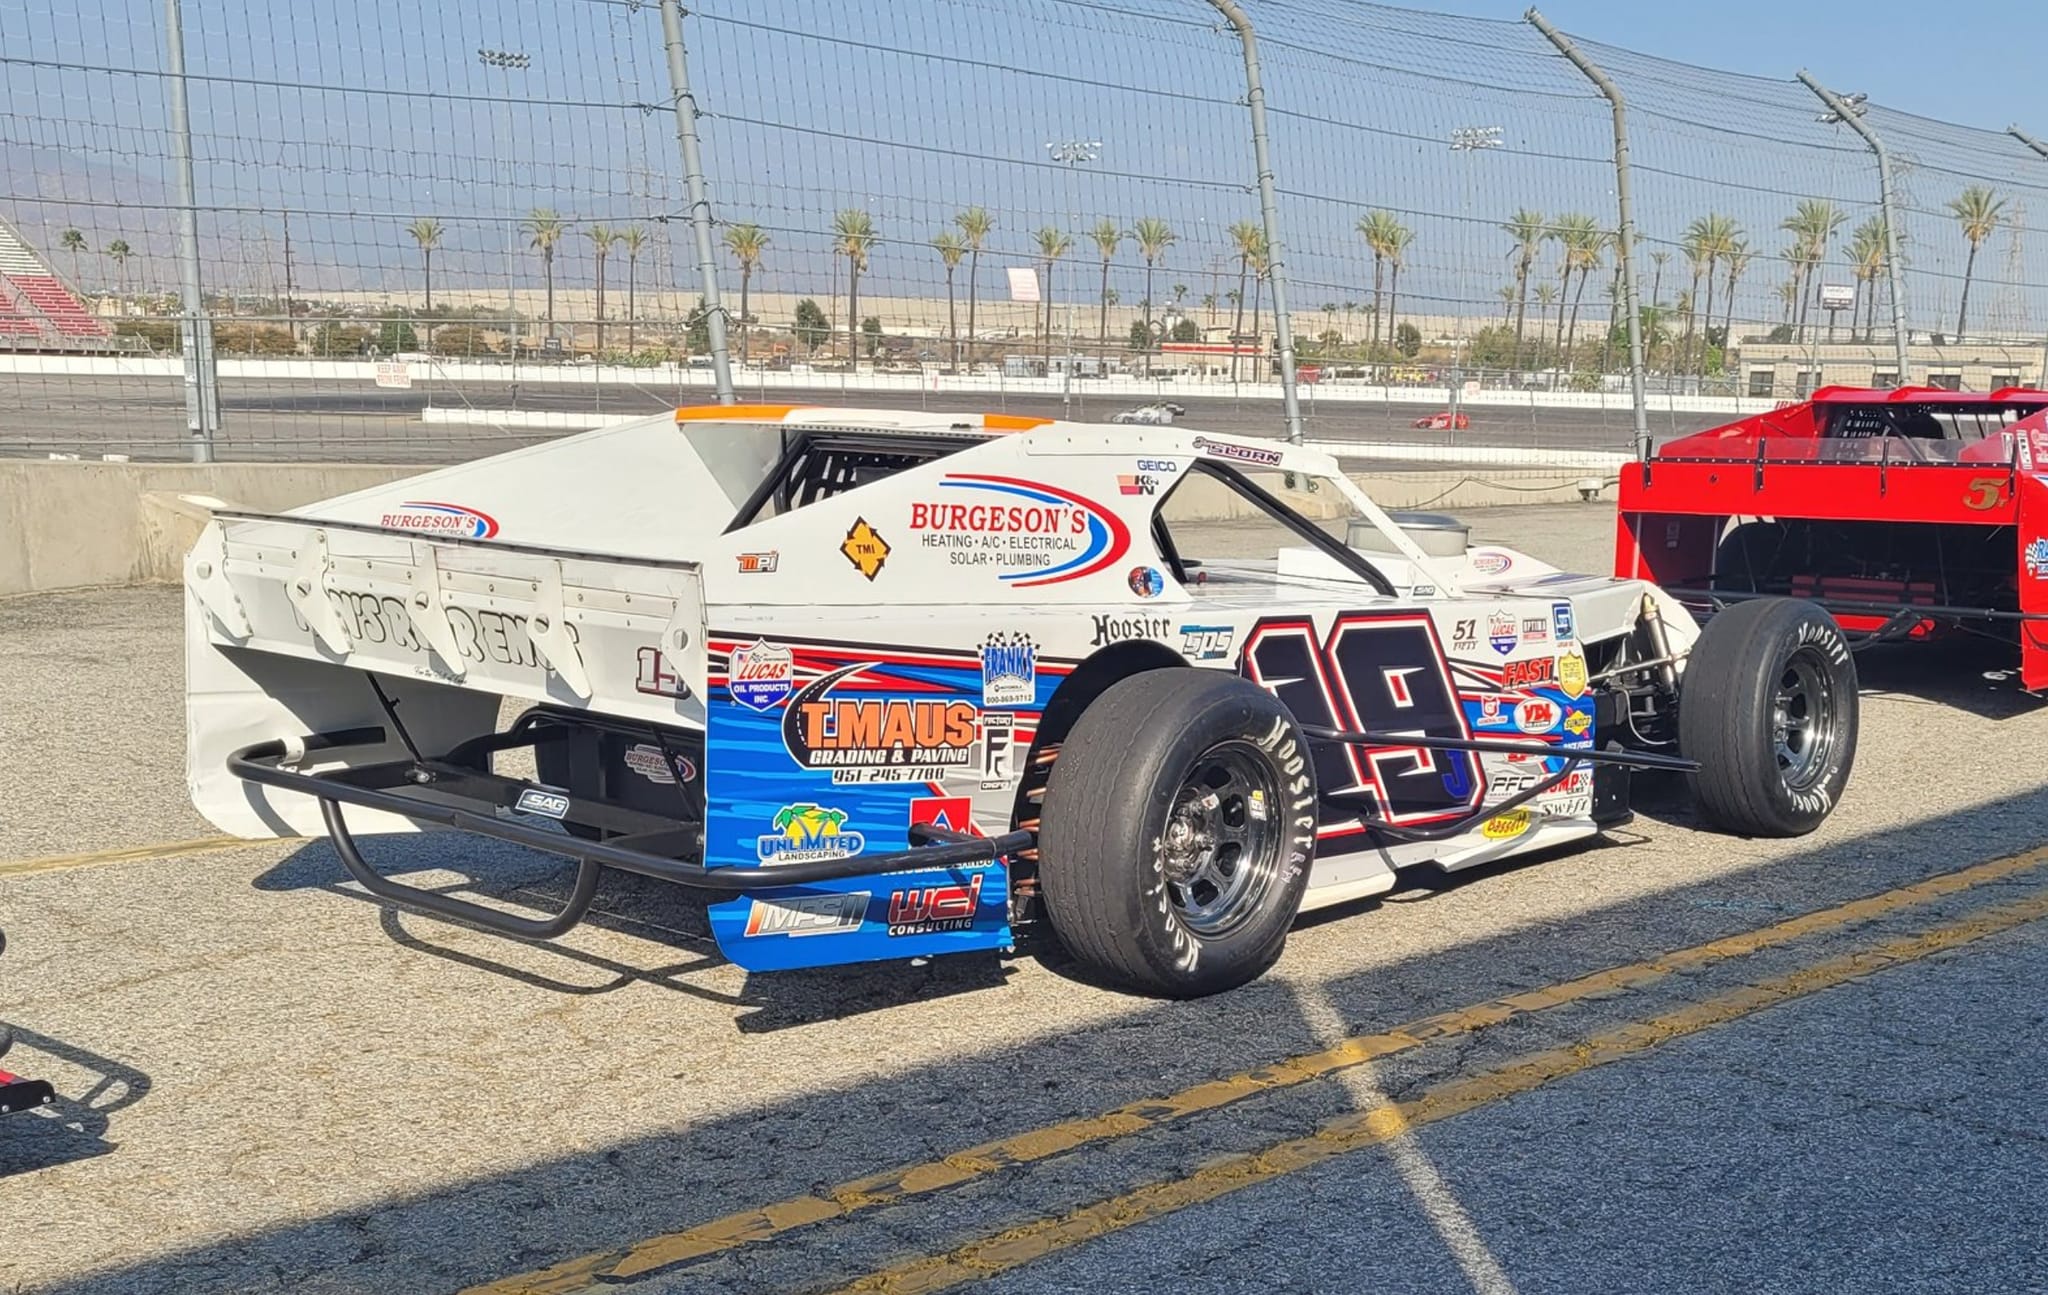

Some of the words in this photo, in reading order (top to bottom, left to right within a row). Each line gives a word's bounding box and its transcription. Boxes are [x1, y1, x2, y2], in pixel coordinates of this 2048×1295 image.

[1136, 459, 1177, 472] GEICO
[381, 514, 477, 530] BURGESON'S
[910, 502, 1086, 534] BURGESON'S
[856, 543, 876, 555] TMI
[921, 533, 973, 549] HEATING
[980, 535, 1001, 550] A/C
[1009, 536, 1078, 551] ELECTRICAL
[950, 551, 987, 566] SOLAR
[996, 552, 1051, 567] PLUMBING
[1090, 612, 1171, 646] Hoosier
[1452, 619, 1477, 641] 51
[635, 646, 692, 700] 1
[738, 662, 788, 680] LUCAS
[1503, 657, 1554, 686] FAST
[733, 684, 748, 693] OIL
[748, 683, 790, 693] PRODUCTS
[753, 695, 769, 704] INC
[801, 701, 977, 750] T.MAUS
[808, 749, 887, 766] GRADING
[891, 749, 905, 764] &
[909, 747, 970, 764] PAVING
[1491, 776, 1535, 792] PFC
[526, 794, 568, 811] SAG
[760, 834, 861, 857] UNLIMITED
[778, 850, 846, 861] LANDSCAPING
[888, 918, 973, 936] CONSULTING
